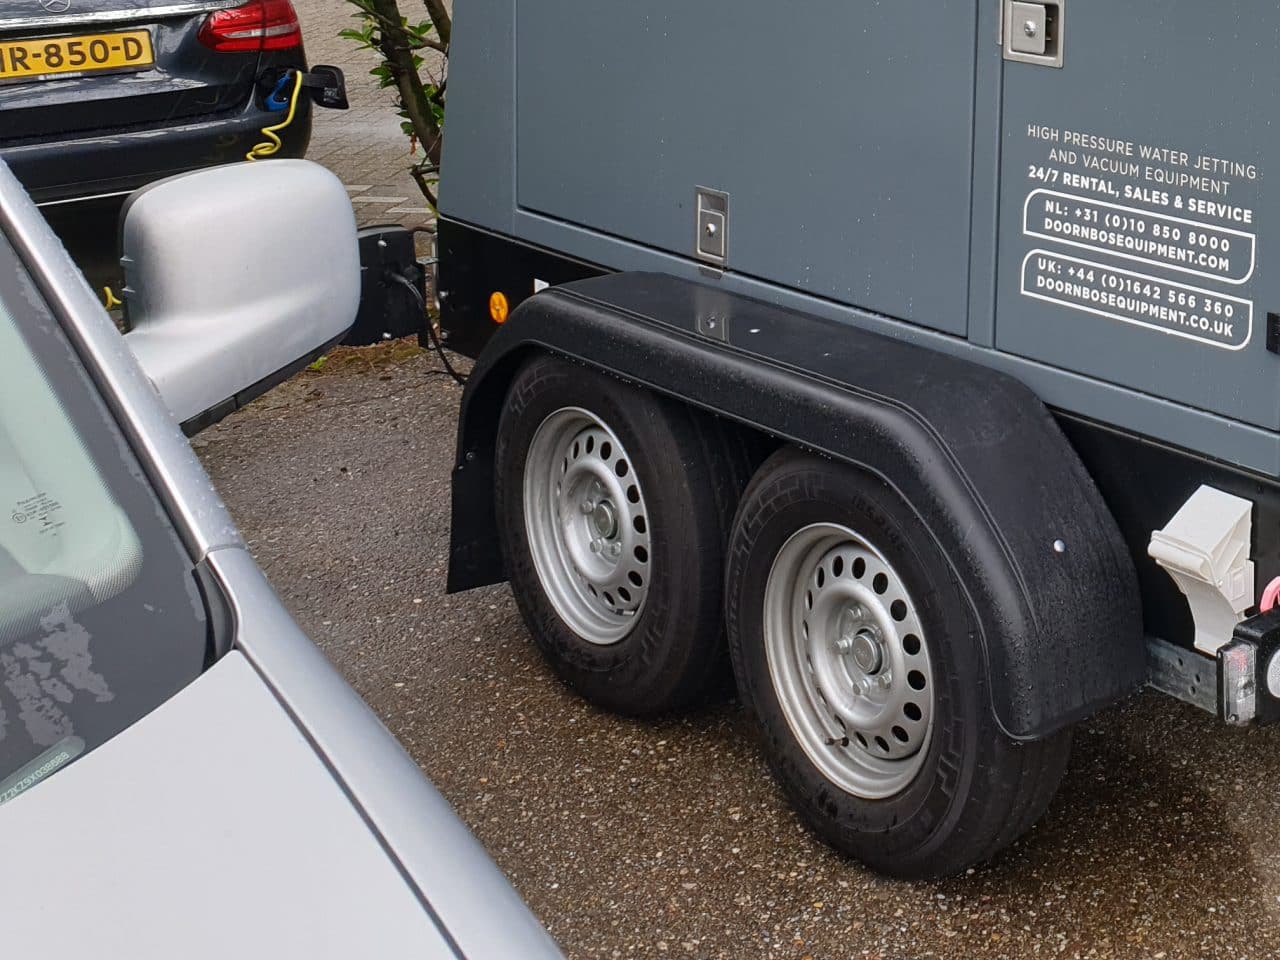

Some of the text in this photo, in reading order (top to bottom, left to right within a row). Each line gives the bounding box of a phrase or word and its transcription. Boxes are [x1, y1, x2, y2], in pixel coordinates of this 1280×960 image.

[1027, 124, 1257, 180] HIGH PRESSURE WATER JETTING
[1049, 148, 1230, 196] AND VACUUM EQUIPMENT
[1028, 165, 1253, 224] 24/7 RENTAL, SALES & SERVICE
[1044, 218, 1230, 271] DOORNBOSEQUIPMENT.COM
[1045, 200, 1230, 252] NL: +31 (0)10 850 8000
[1036, 275, 1234, 337] DOORNBOSEQUIPMENT.CO.UK
[1038, 257, 1234, 318] UK: +44 (0)1642 566 360
